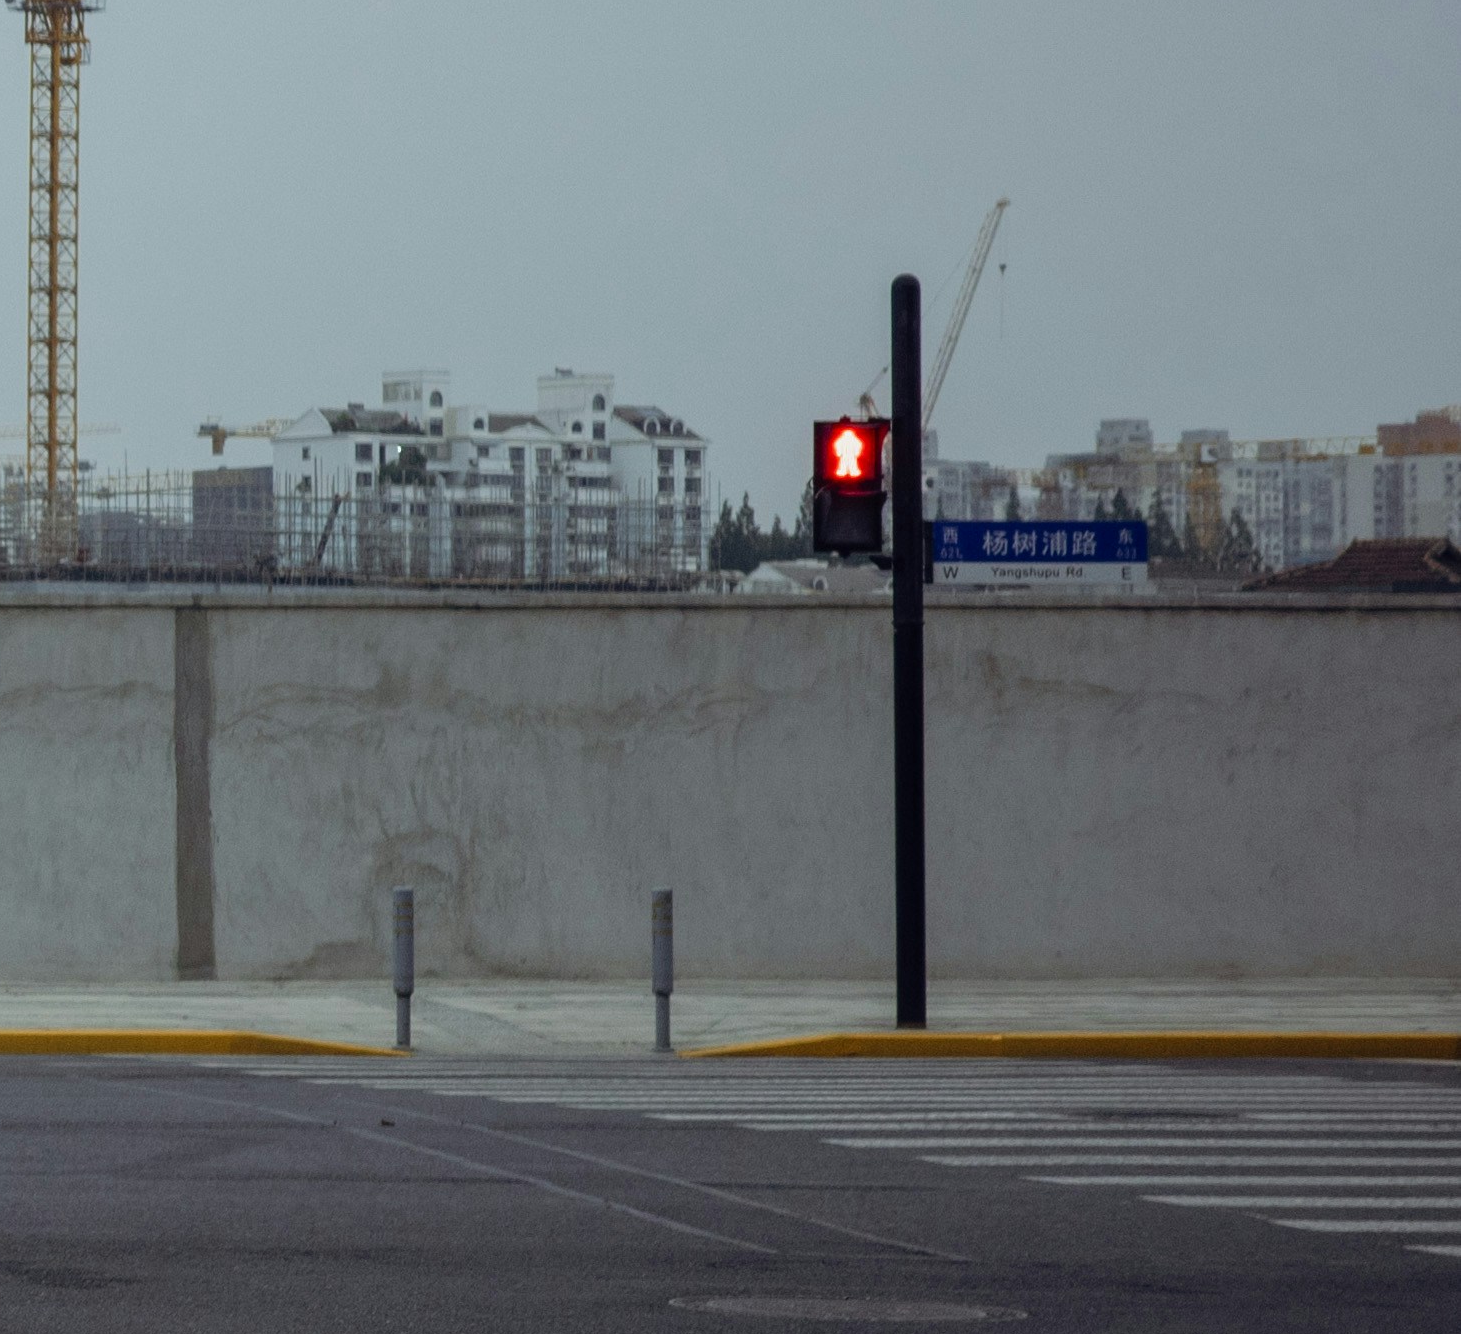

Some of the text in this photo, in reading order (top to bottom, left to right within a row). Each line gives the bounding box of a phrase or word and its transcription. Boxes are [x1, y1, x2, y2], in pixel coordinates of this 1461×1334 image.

[943, 526, 958, 544] 西
[1118, 528, 1133, 545] 东
[983, 529, 1097, 557] 杨树浦路
[943, 566, 959, 579] W
[991, 566, 1060, 580] Yangshupu
[1121, 567, 1132, 581] E
